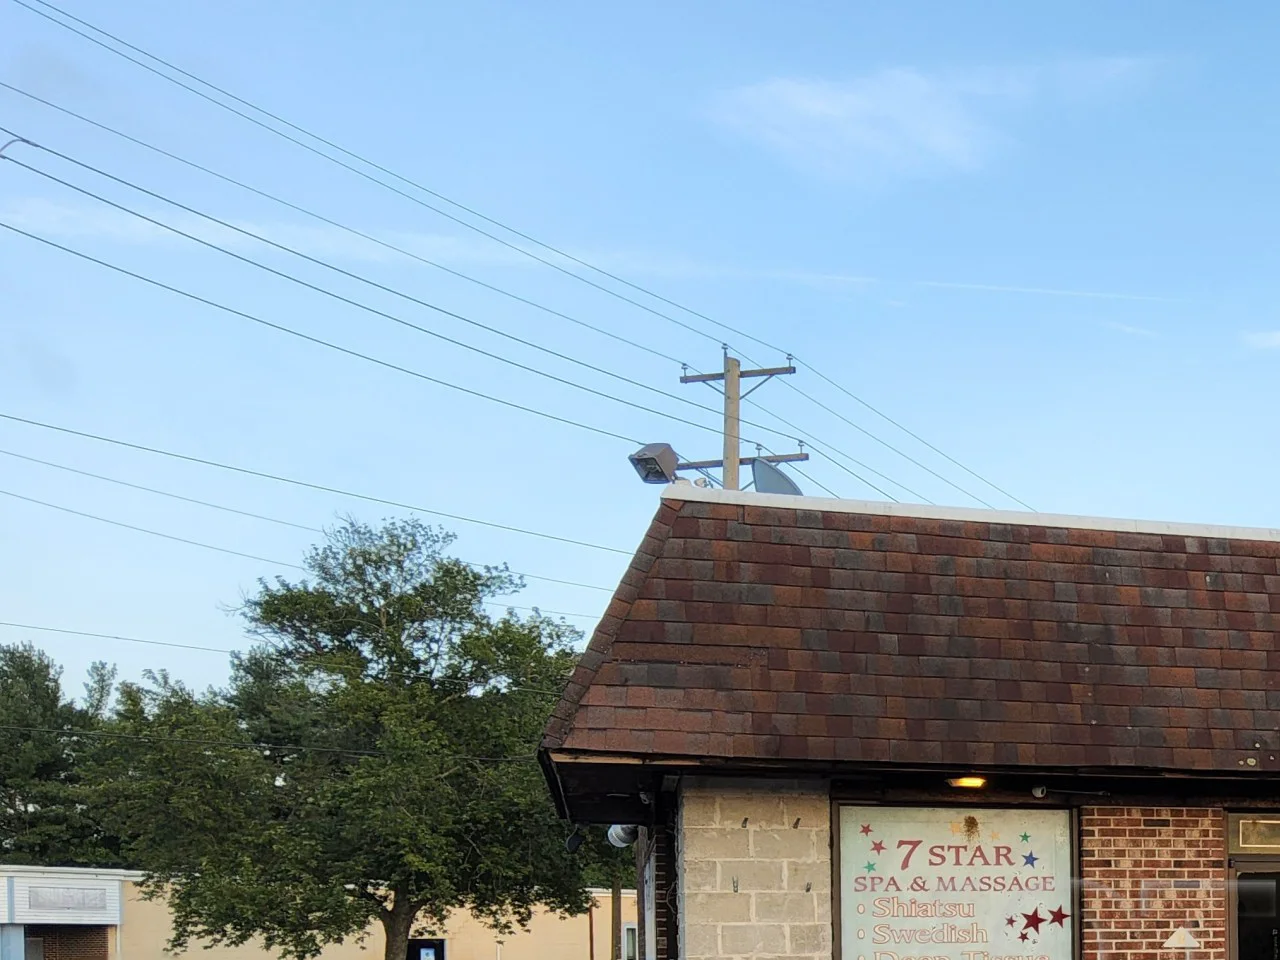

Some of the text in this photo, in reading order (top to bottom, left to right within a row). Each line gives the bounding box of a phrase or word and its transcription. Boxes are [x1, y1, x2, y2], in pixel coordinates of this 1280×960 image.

[896, 840, 1015, 871] 7 STAR
[854, 875, 1055, 892] SPA & MASSAGE
[872, 896, 975, 918] Shiatsu
[872, 923, 988, 944] Swedish
